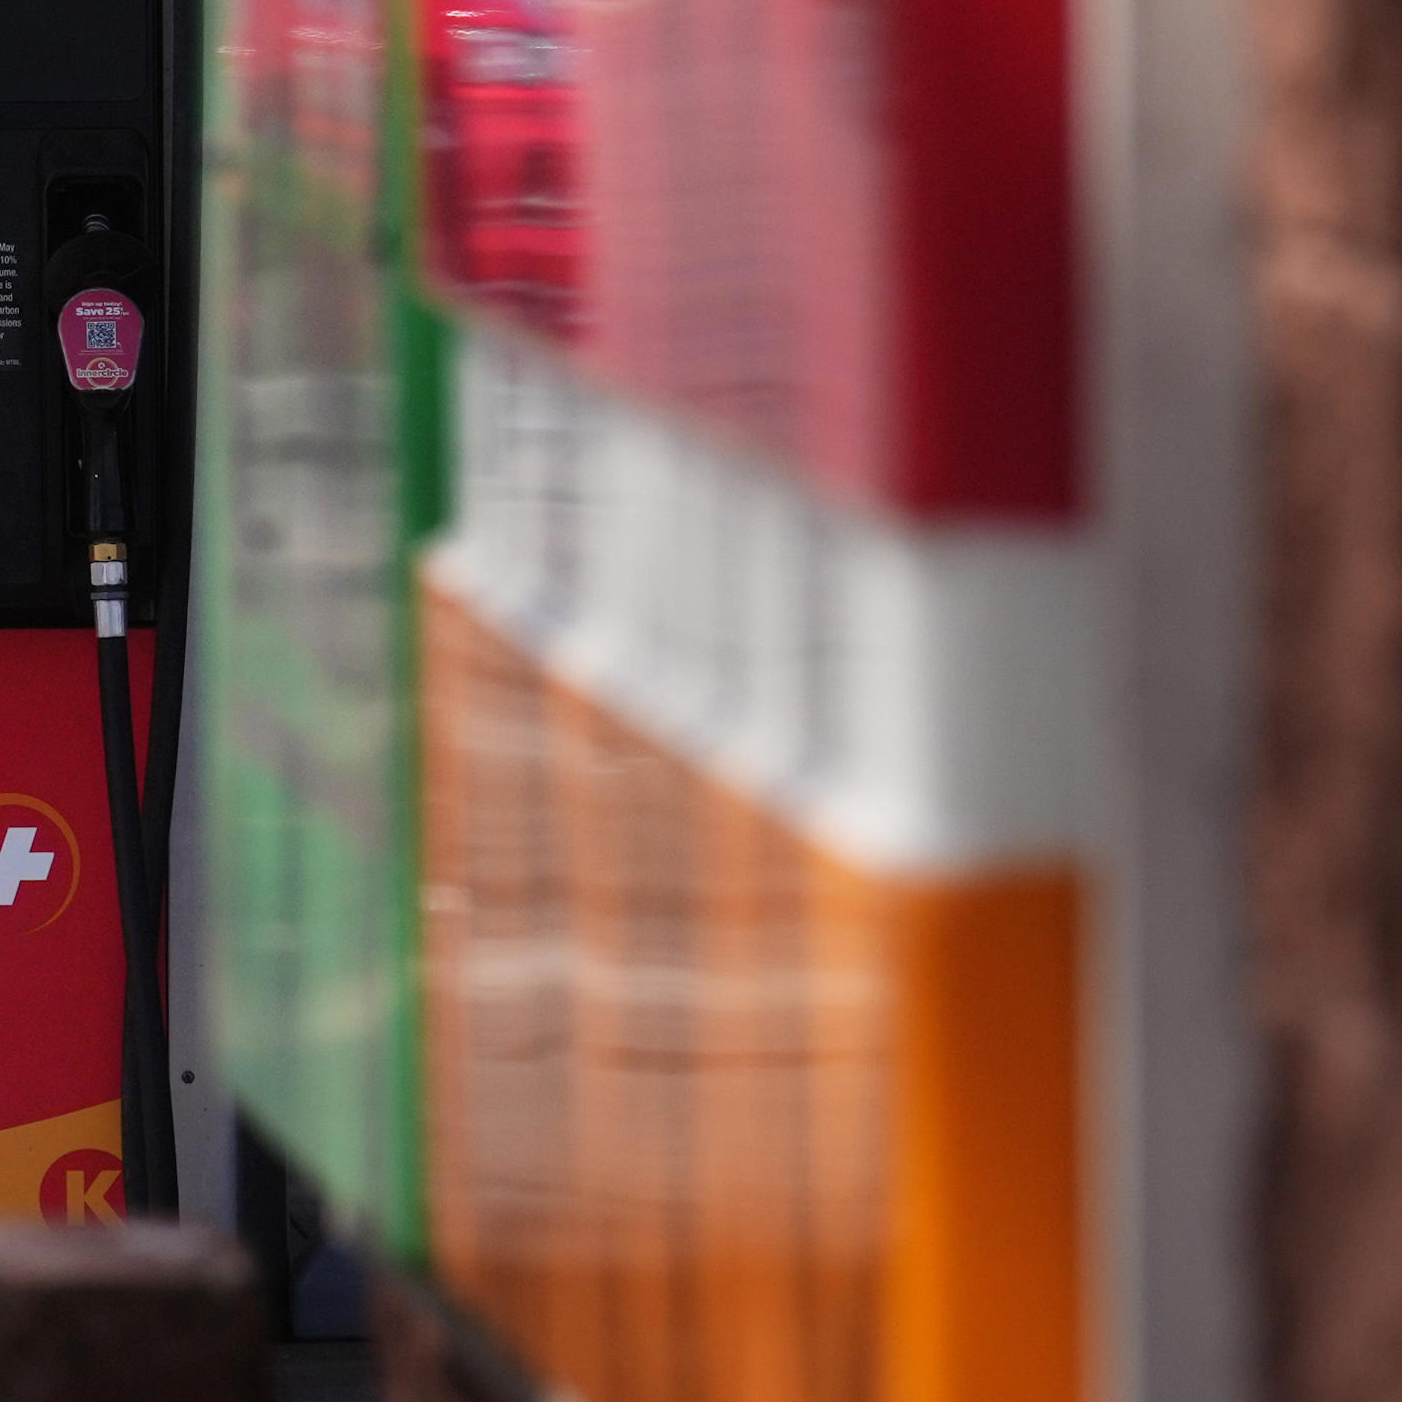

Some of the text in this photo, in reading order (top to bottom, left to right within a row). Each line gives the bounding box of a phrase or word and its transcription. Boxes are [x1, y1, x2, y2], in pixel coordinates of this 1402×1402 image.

[0, 243, 15, 252] May
[0, 256, 17, 264] 10%
[5, 281, 12, 289] is
[0, 293, 13, 302] and
[76, 308, 104, 316] Save
